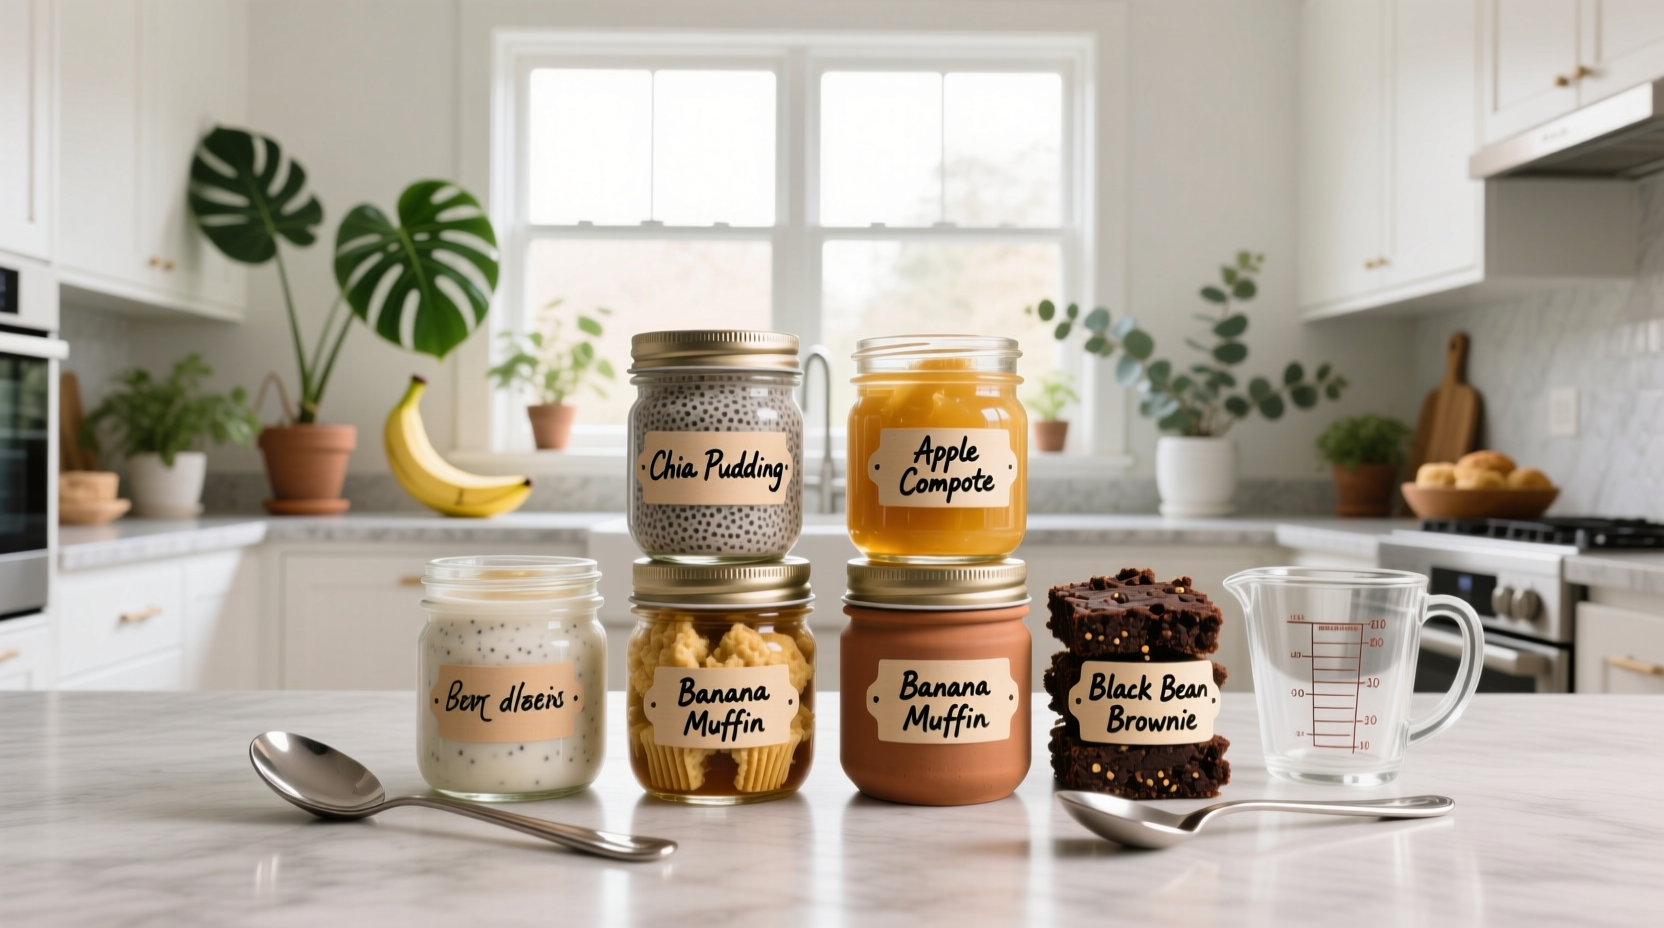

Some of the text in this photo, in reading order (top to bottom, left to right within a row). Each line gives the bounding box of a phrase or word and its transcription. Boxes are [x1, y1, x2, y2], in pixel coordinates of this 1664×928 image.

[649, 448, 784, 493] Chia Pudding
[912, 434, 980, 474] Apple
[898, 466, 996, 504] Compote
[677, 676, 771, 708] Banana
[898, 669, 992, 701] Banana
[1088, 671, 1209, 703] Black Bean
[682, 708, 766, 743] Muffin
[902, 703, 991, 739] Muffin
[1106, 704, 1199, 734] Brownie
